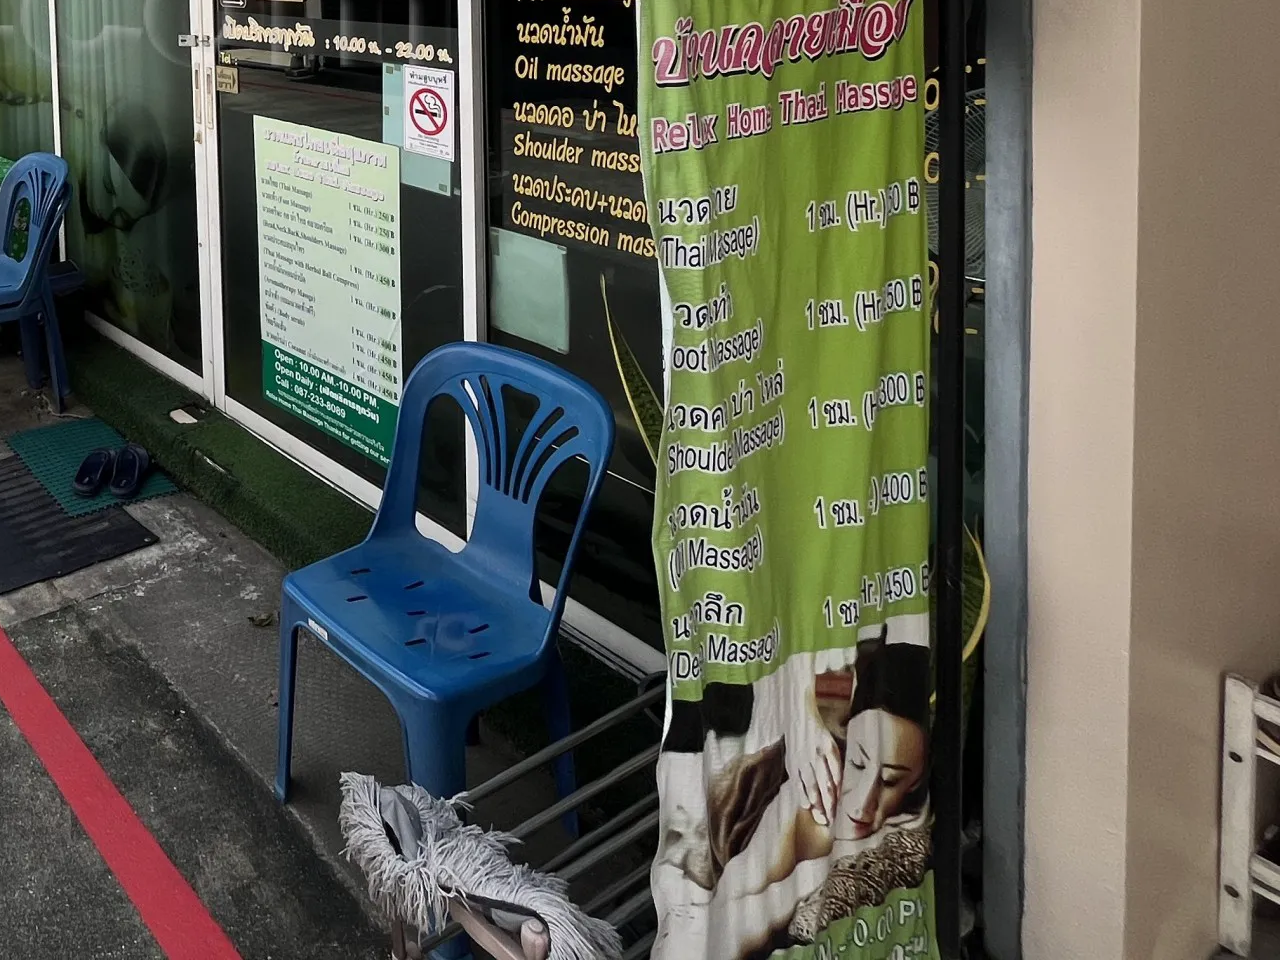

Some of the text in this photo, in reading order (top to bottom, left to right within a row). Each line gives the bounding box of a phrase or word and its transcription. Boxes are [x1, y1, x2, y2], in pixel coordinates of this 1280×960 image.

[516, 6, 605, 48] นวดน้ำมัน
[333, 35, 366, 54] 10.00
[395, 42, 435, 62] 22.00
[515, 55, 625, 93] Oil massage
[513, 101, 574, 128] นวดคอ
[651, 114, 718, 154] Relx
[779, 82, 828, 126] Thai
[513, 133, 642, 173] Shoulder mass
[513, 172, 650, 224] นวดประคบ+นวด
[511, 201, 657, 260] Compression mas
[661, 237, 706, 267] Thai
[674, 284, 733, 328] วดเท้า
[274, 349, 294, 366] Open
[299, 361, 320, 379] 10.00
[274, 361, 294, 379] Open
[295, 371, 314, 390] Daily
[275, 375, 347, 419] Call 087-233-8089
[823, 400, 856, 425] ชม.
[831, 502, 863, 525] ชม.
[882, 475, 911, 502] 400
[689, 529, 762, 570] Massage)
[885, 570, 913, 603] 450
